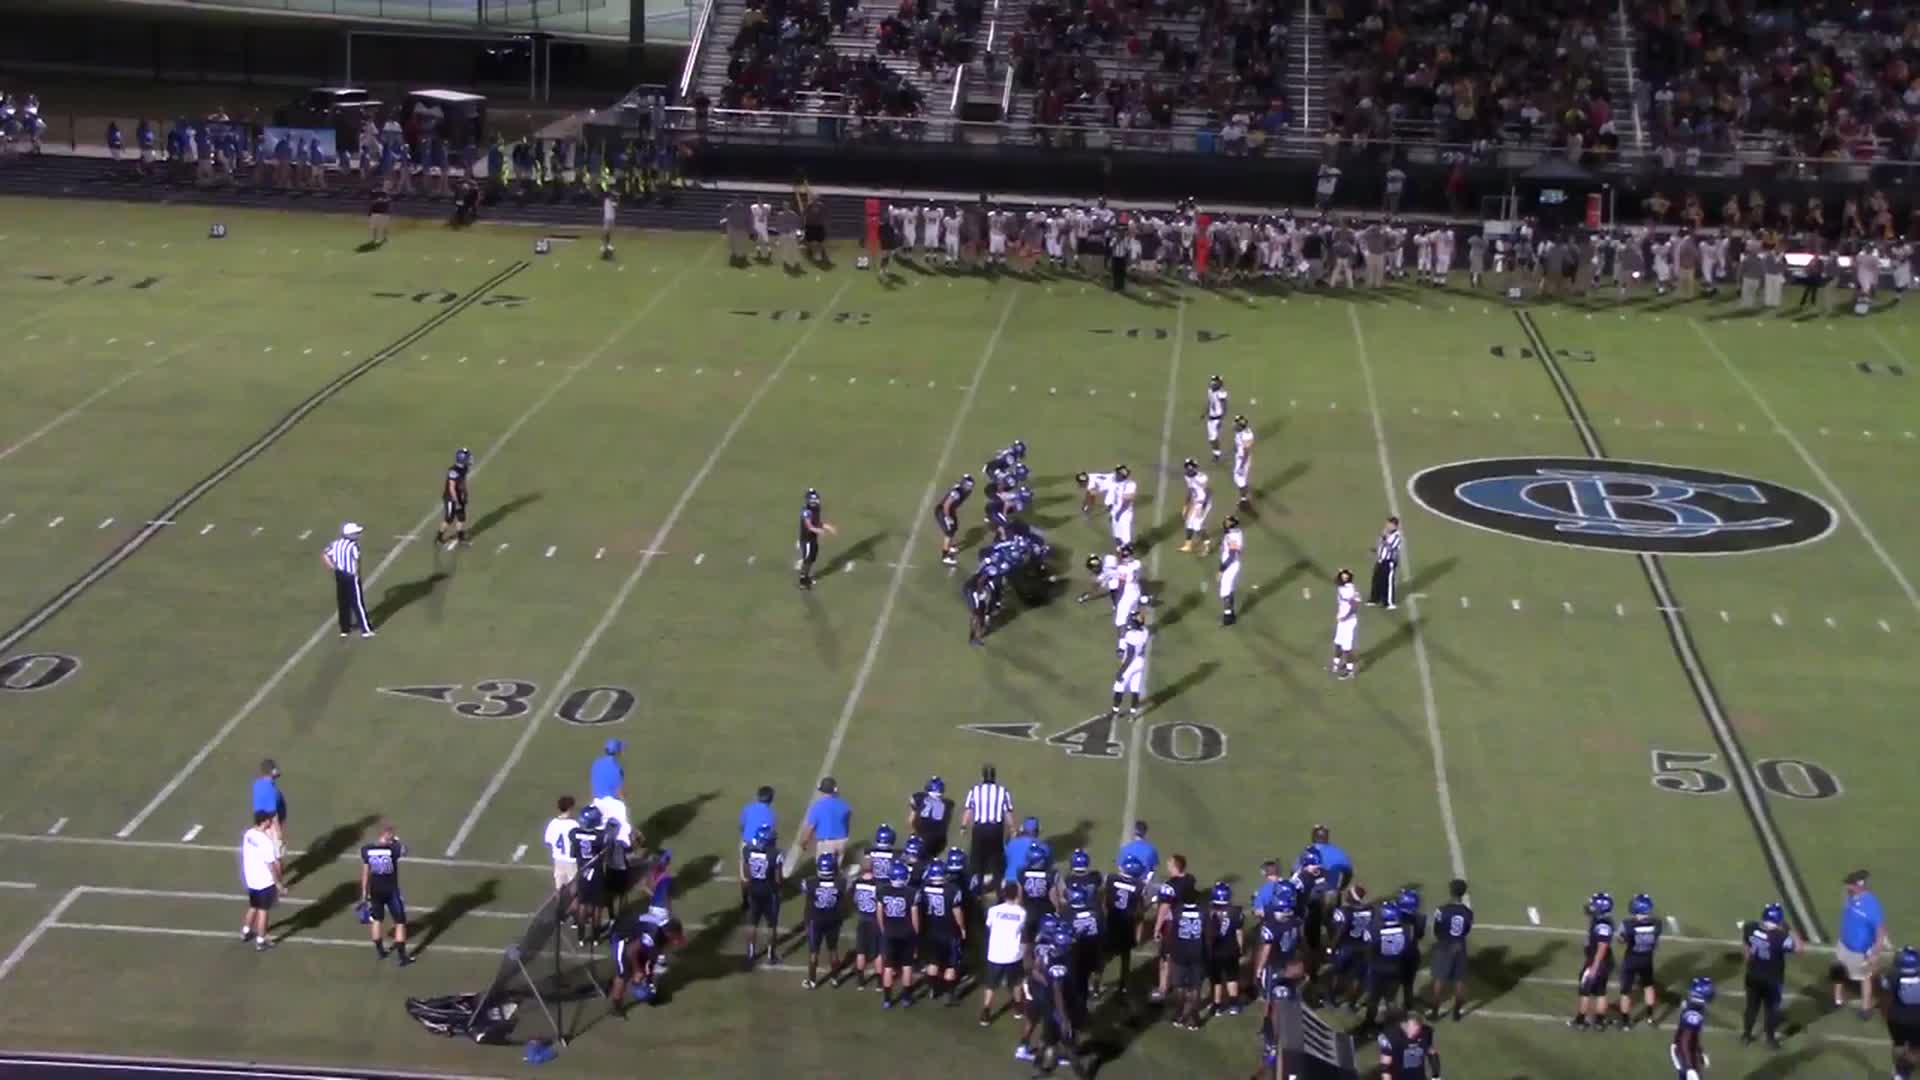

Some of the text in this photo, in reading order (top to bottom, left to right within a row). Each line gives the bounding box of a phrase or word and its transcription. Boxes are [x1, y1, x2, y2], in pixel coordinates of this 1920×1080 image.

[453, 679, 638, 726] 30
[1044, 712, 1228, 763] 40
[1650, 749, 1844, 799] 50
[555, 833, 567, 855] 4
